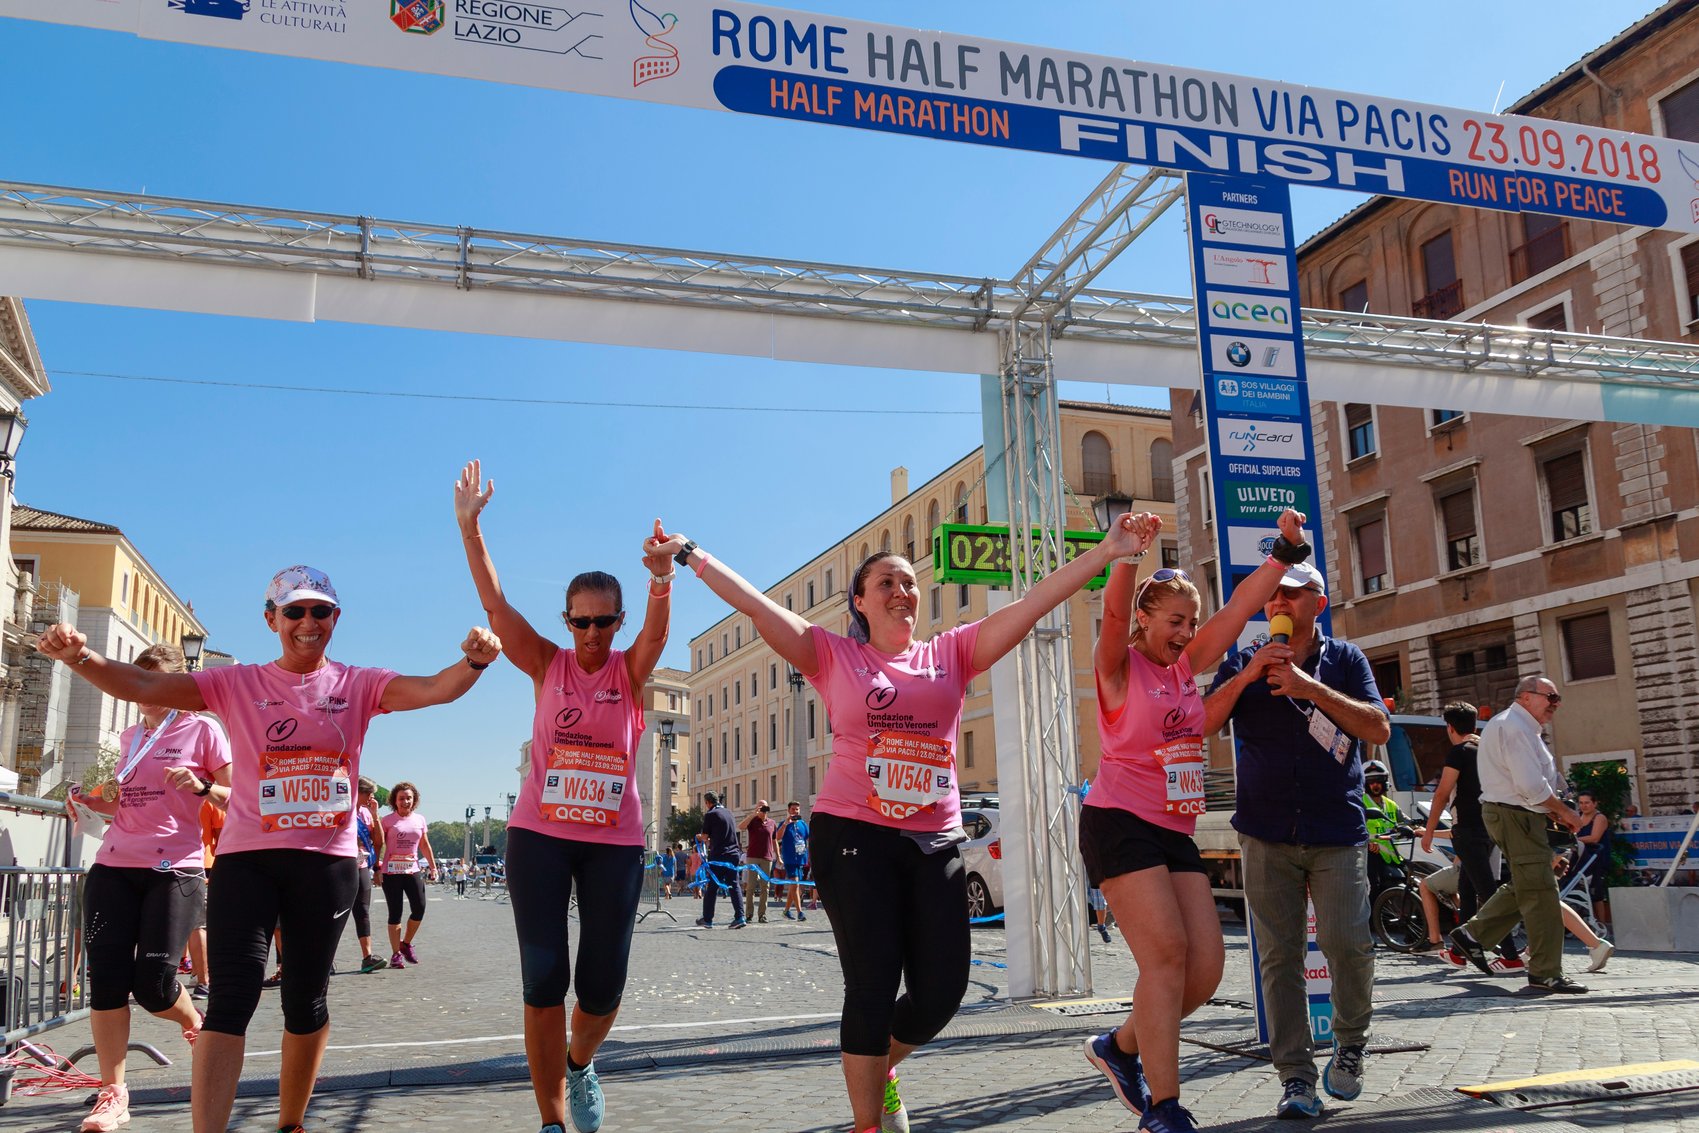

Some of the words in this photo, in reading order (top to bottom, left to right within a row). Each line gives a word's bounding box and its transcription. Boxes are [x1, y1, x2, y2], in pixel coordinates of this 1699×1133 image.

[281, 1, 347, 18] ATTIVITÀ
[455, 0, 552, 25] REGIONE
[260, 13, 346, 33] CULTURALI
[454, 21, 521, 44] LAZIO
[713, 9, 848, 74] ROME
[867, 32, 981, 90] HALF
[999, 51, 1239, 127] MARATHON
[1252, 86, 1324, 139] VIA
[1336, 98, 1452, 156] PACIS
[1463, 119, 1661, 184] 23.09.2018
[770, 78, 844, 116] HALF
[854, 90, 1009, 140] MARATHON
[1059, 115, 1406, 192] FINISH
[1222, 191, 1258, 205] PARTNERS
[1448, 168, 1497, 201] RUN
[1505, 175, 1547, 208] FOR
[1556, 183, 1626, 217] PEACE
[1212, 300, 1288, 325] acea
[1241, 381, 1258, 390] SOS
[1260, 382, 1295, 392] VILLAGGI
[1242, 390, 1255, 398] DEI
[1257, 391, 1291, 401] BAMBINI
[1242, 400, 1267, 408] ITALIA
[1229, 463, 1261, 475] OFFICIAL
[1262, 466, 1301, 477] SUPPLIERS
[1237, 487, 1295, 503] ULIVETO
[865, 712, 914, 721] Fondazione
[867, 720, 904, 729] Umberto
[904, 720, 938, 729] Veronesi
[554, 729, 593, 741] Fondazione
[554, 737, 584, 747] Umberto
[584, 741, 615, 749] Veronesi
[886, 738, 904, 746] ROME
[904, 740, 920, 748] HALF
[565, 750, 580, 758] ROME
[581, 752, 595, 760] HALF
[886, 746, 897, 754] VIA
[897, 748, 916, 756] PACIS
[279, 758, 297, 766] ROME
[298, 756, 314, 764] HALF
[279, 765, 290, 773] VIA
[291, 764, 310, 772] PACIS
[575, 759, 591, 767] PACIS
[886, 762, 932, 794] W548
[282, 778, 330, 804] W505
[564, 776, 606, 803] W636
[277, 813, 335, 829] acea
[555, 806, 607, 824] acea
